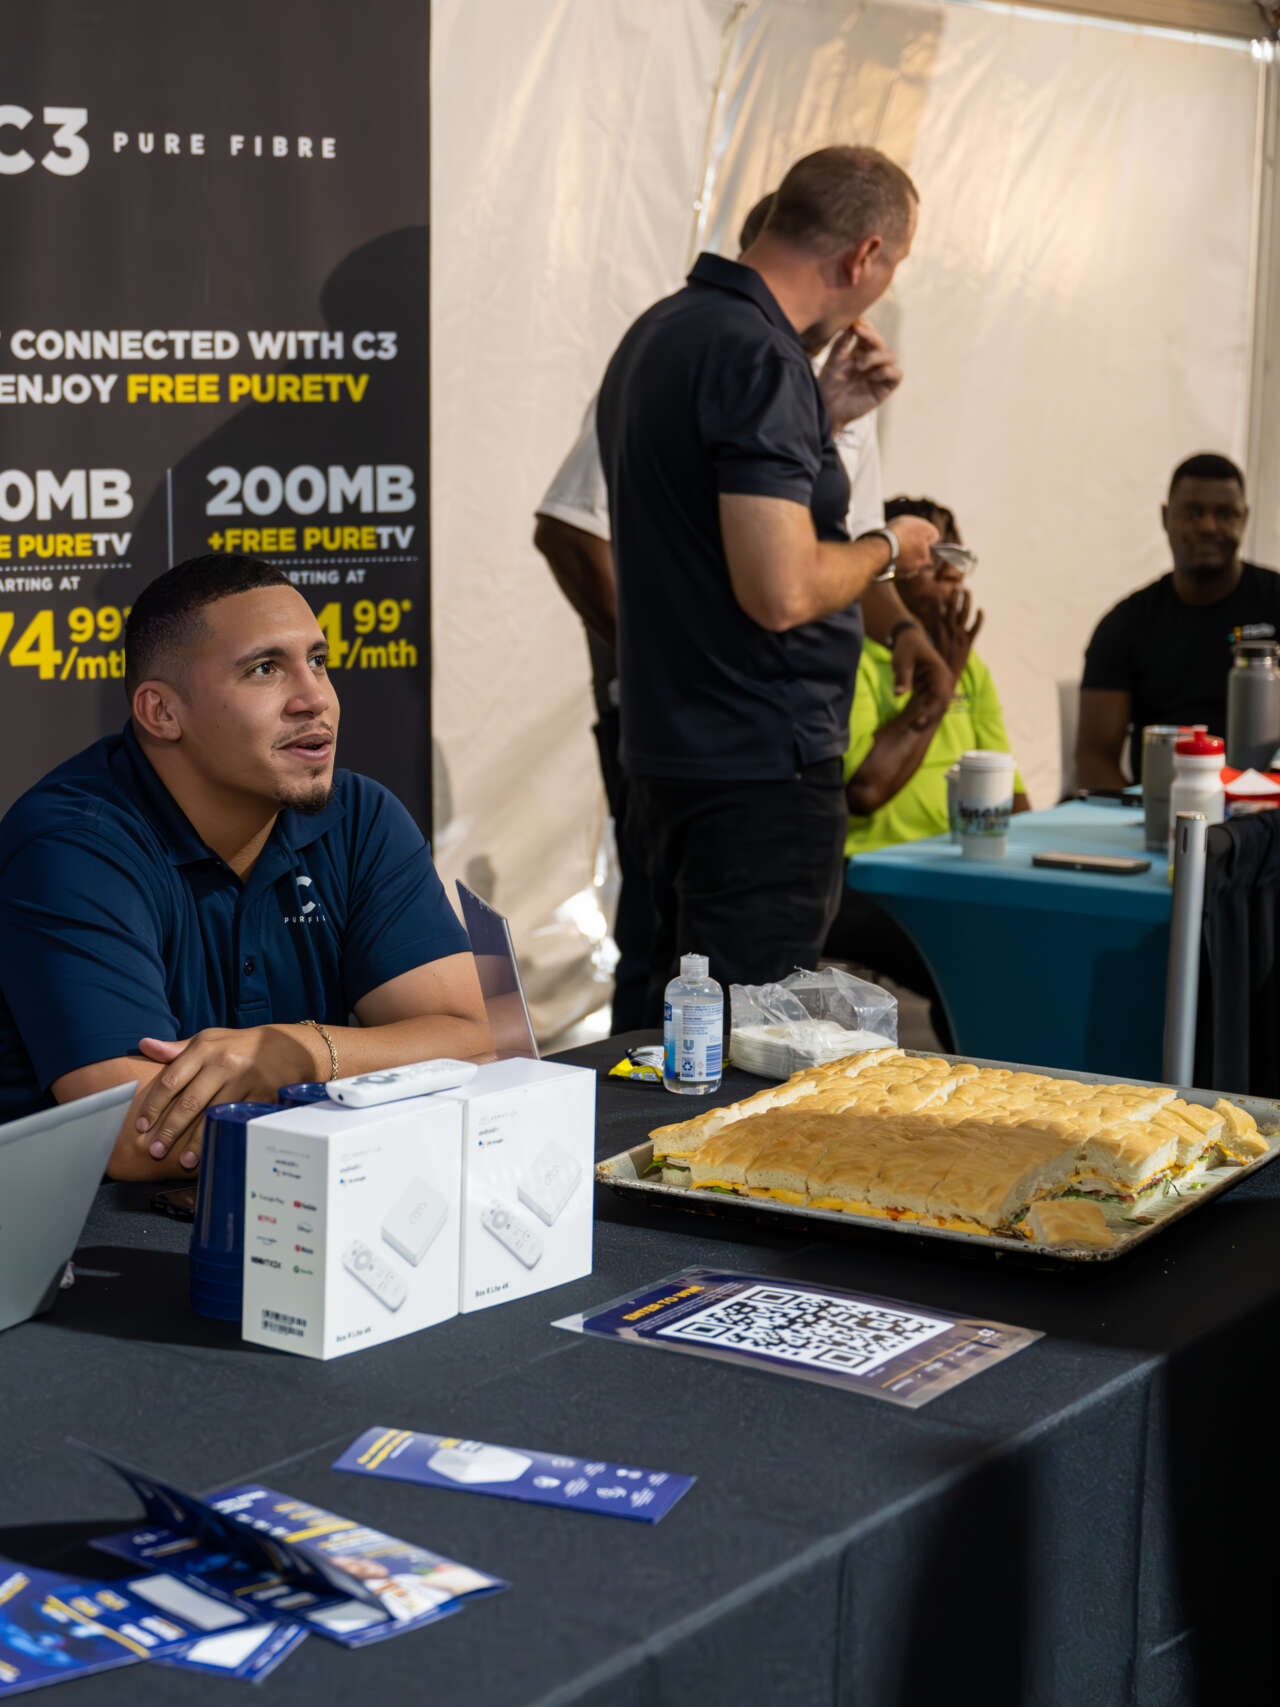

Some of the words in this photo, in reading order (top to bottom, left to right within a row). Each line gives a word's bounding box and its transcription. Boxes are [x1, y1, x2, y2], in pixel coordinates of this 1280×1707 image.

[114, 131, 206, 155] PURE
[230, 135, 336, 159] FIBRE
[10, 330, 240, 360] CONNECTED
[247, 331, 344, 360] WITH
[352, 331, 398, 360] C3
[127, 374, 220, 403] FREE
[229, 373, 370, 403] PURETV
[205, 465, 416, 516] 200MB
[18, 532, 132, 559] PURETV
[208, 527, 296, 553] +FREE
[303, 525, 415, 551] PURETV
[59, 576, 81, 592] AT
[282, 570, 339, 585] RTING
[345, 569, 366, 584] AT
